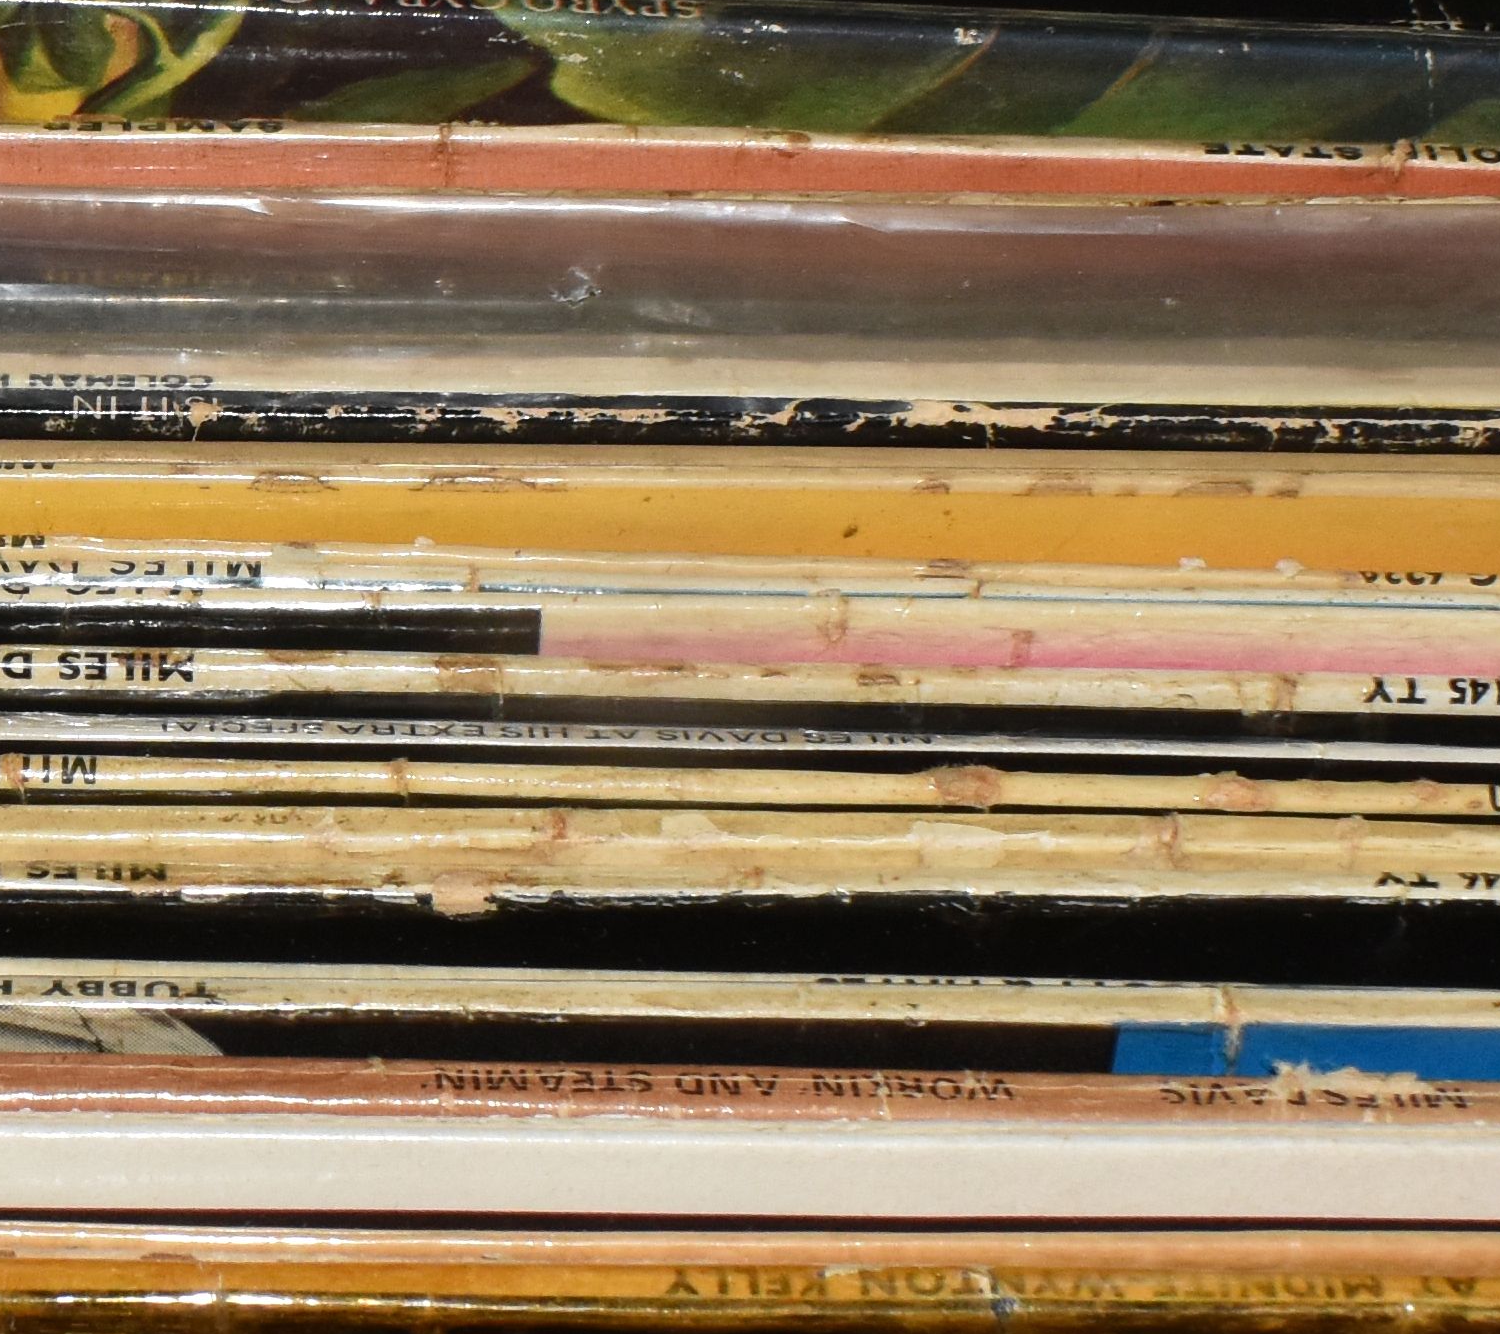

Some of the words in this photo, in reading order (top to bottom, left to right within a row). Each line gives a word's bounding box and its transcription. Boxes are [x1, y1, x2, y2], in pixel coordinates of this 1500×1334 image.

[1203, 142, 1364, 162] STATE
[72, 395, 117, 421] IN
[54, 651, 196, 684] MILES
[1362, 676, 1427, 705] TY
[335, 722, 485, 741] EXTRA
[34, 977, 221, 1003] TUBBY
[679, 1071, 779, 1099] AND
[661, 1269, 828, 1299] KELLY
[855, 1270, 1120, 1302] WYNTON
[1409, 1277, 1481, 1304] AT
